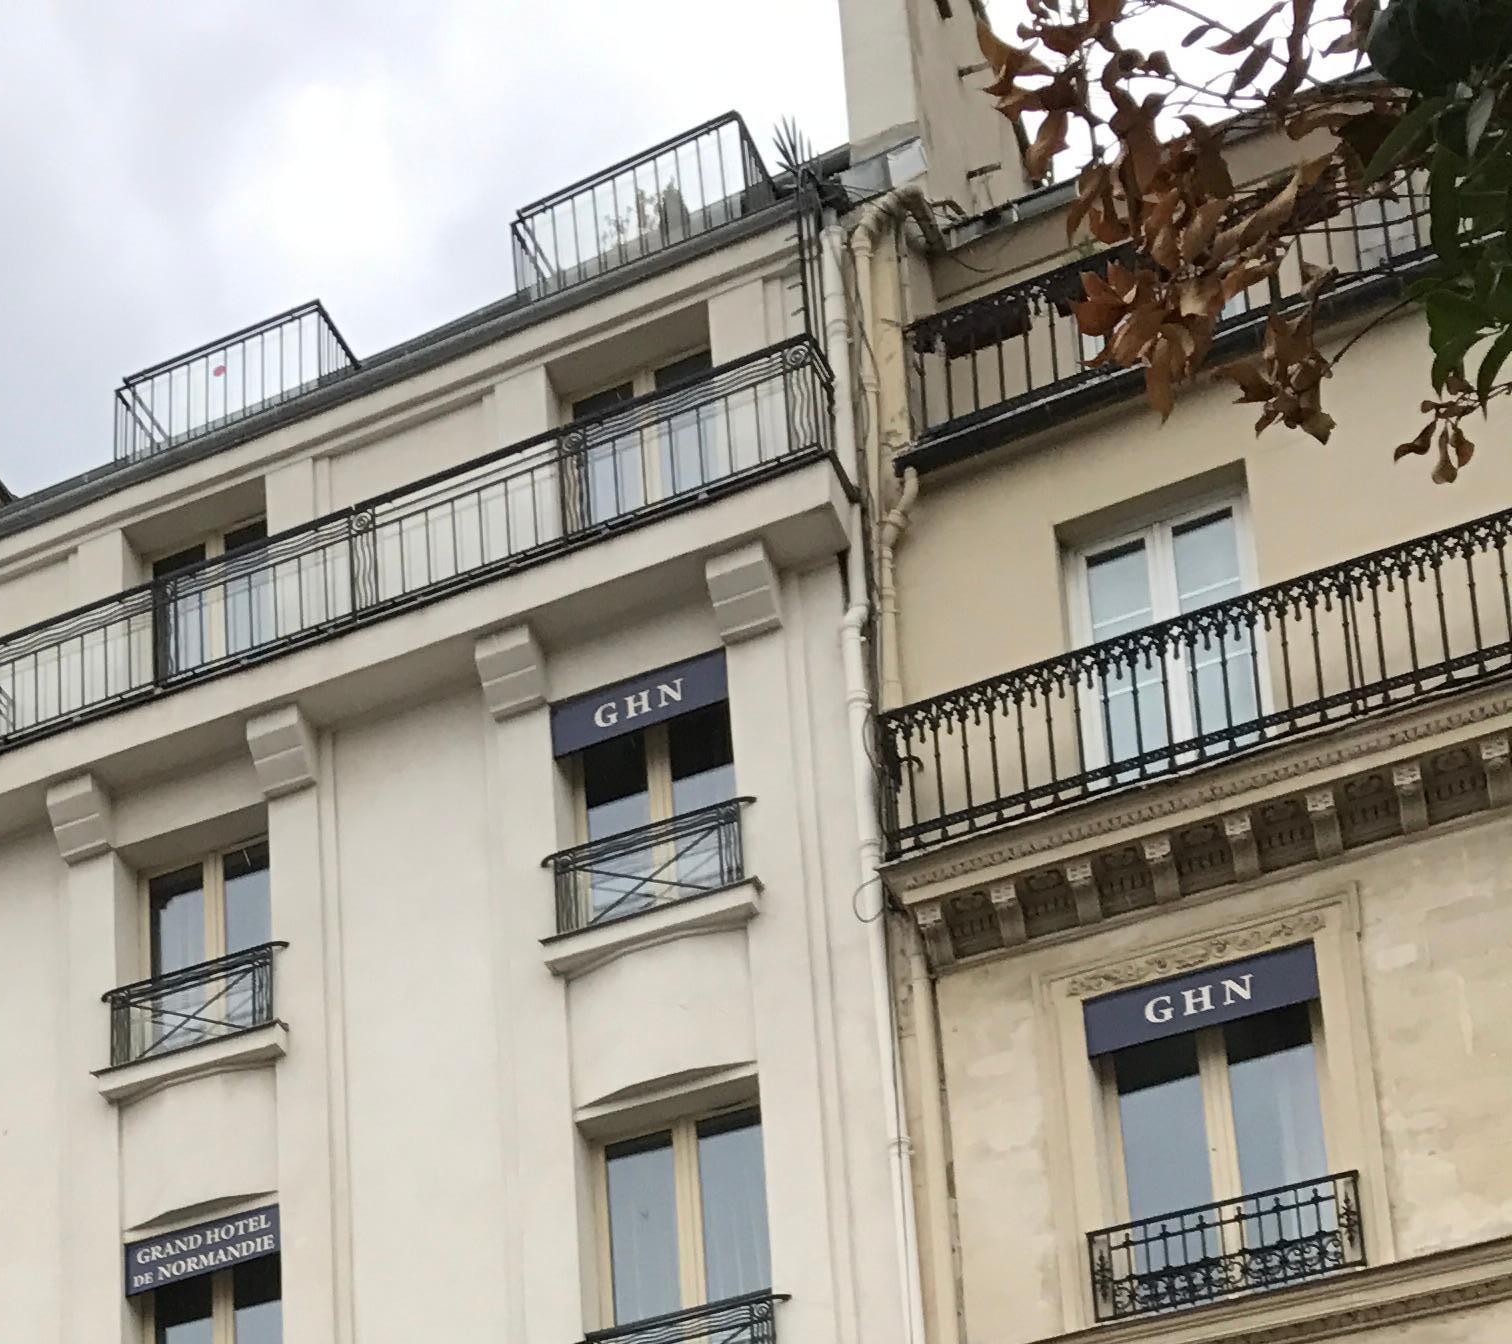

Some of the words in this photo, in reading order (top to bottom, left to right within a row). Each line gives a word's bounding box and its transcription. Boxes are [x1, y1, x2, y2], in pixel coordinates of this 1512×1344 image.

[594, 677, 684, 728] GHN
[1144, 973, 1254, 1024] GHN
[133, 1271, 154, 1288] DE
[157, 1234, 275, 1281] NORMANDIE
[136, 1233, 203, 1264] GRAND
[205, 1214, 271, 1245] HOTEL
